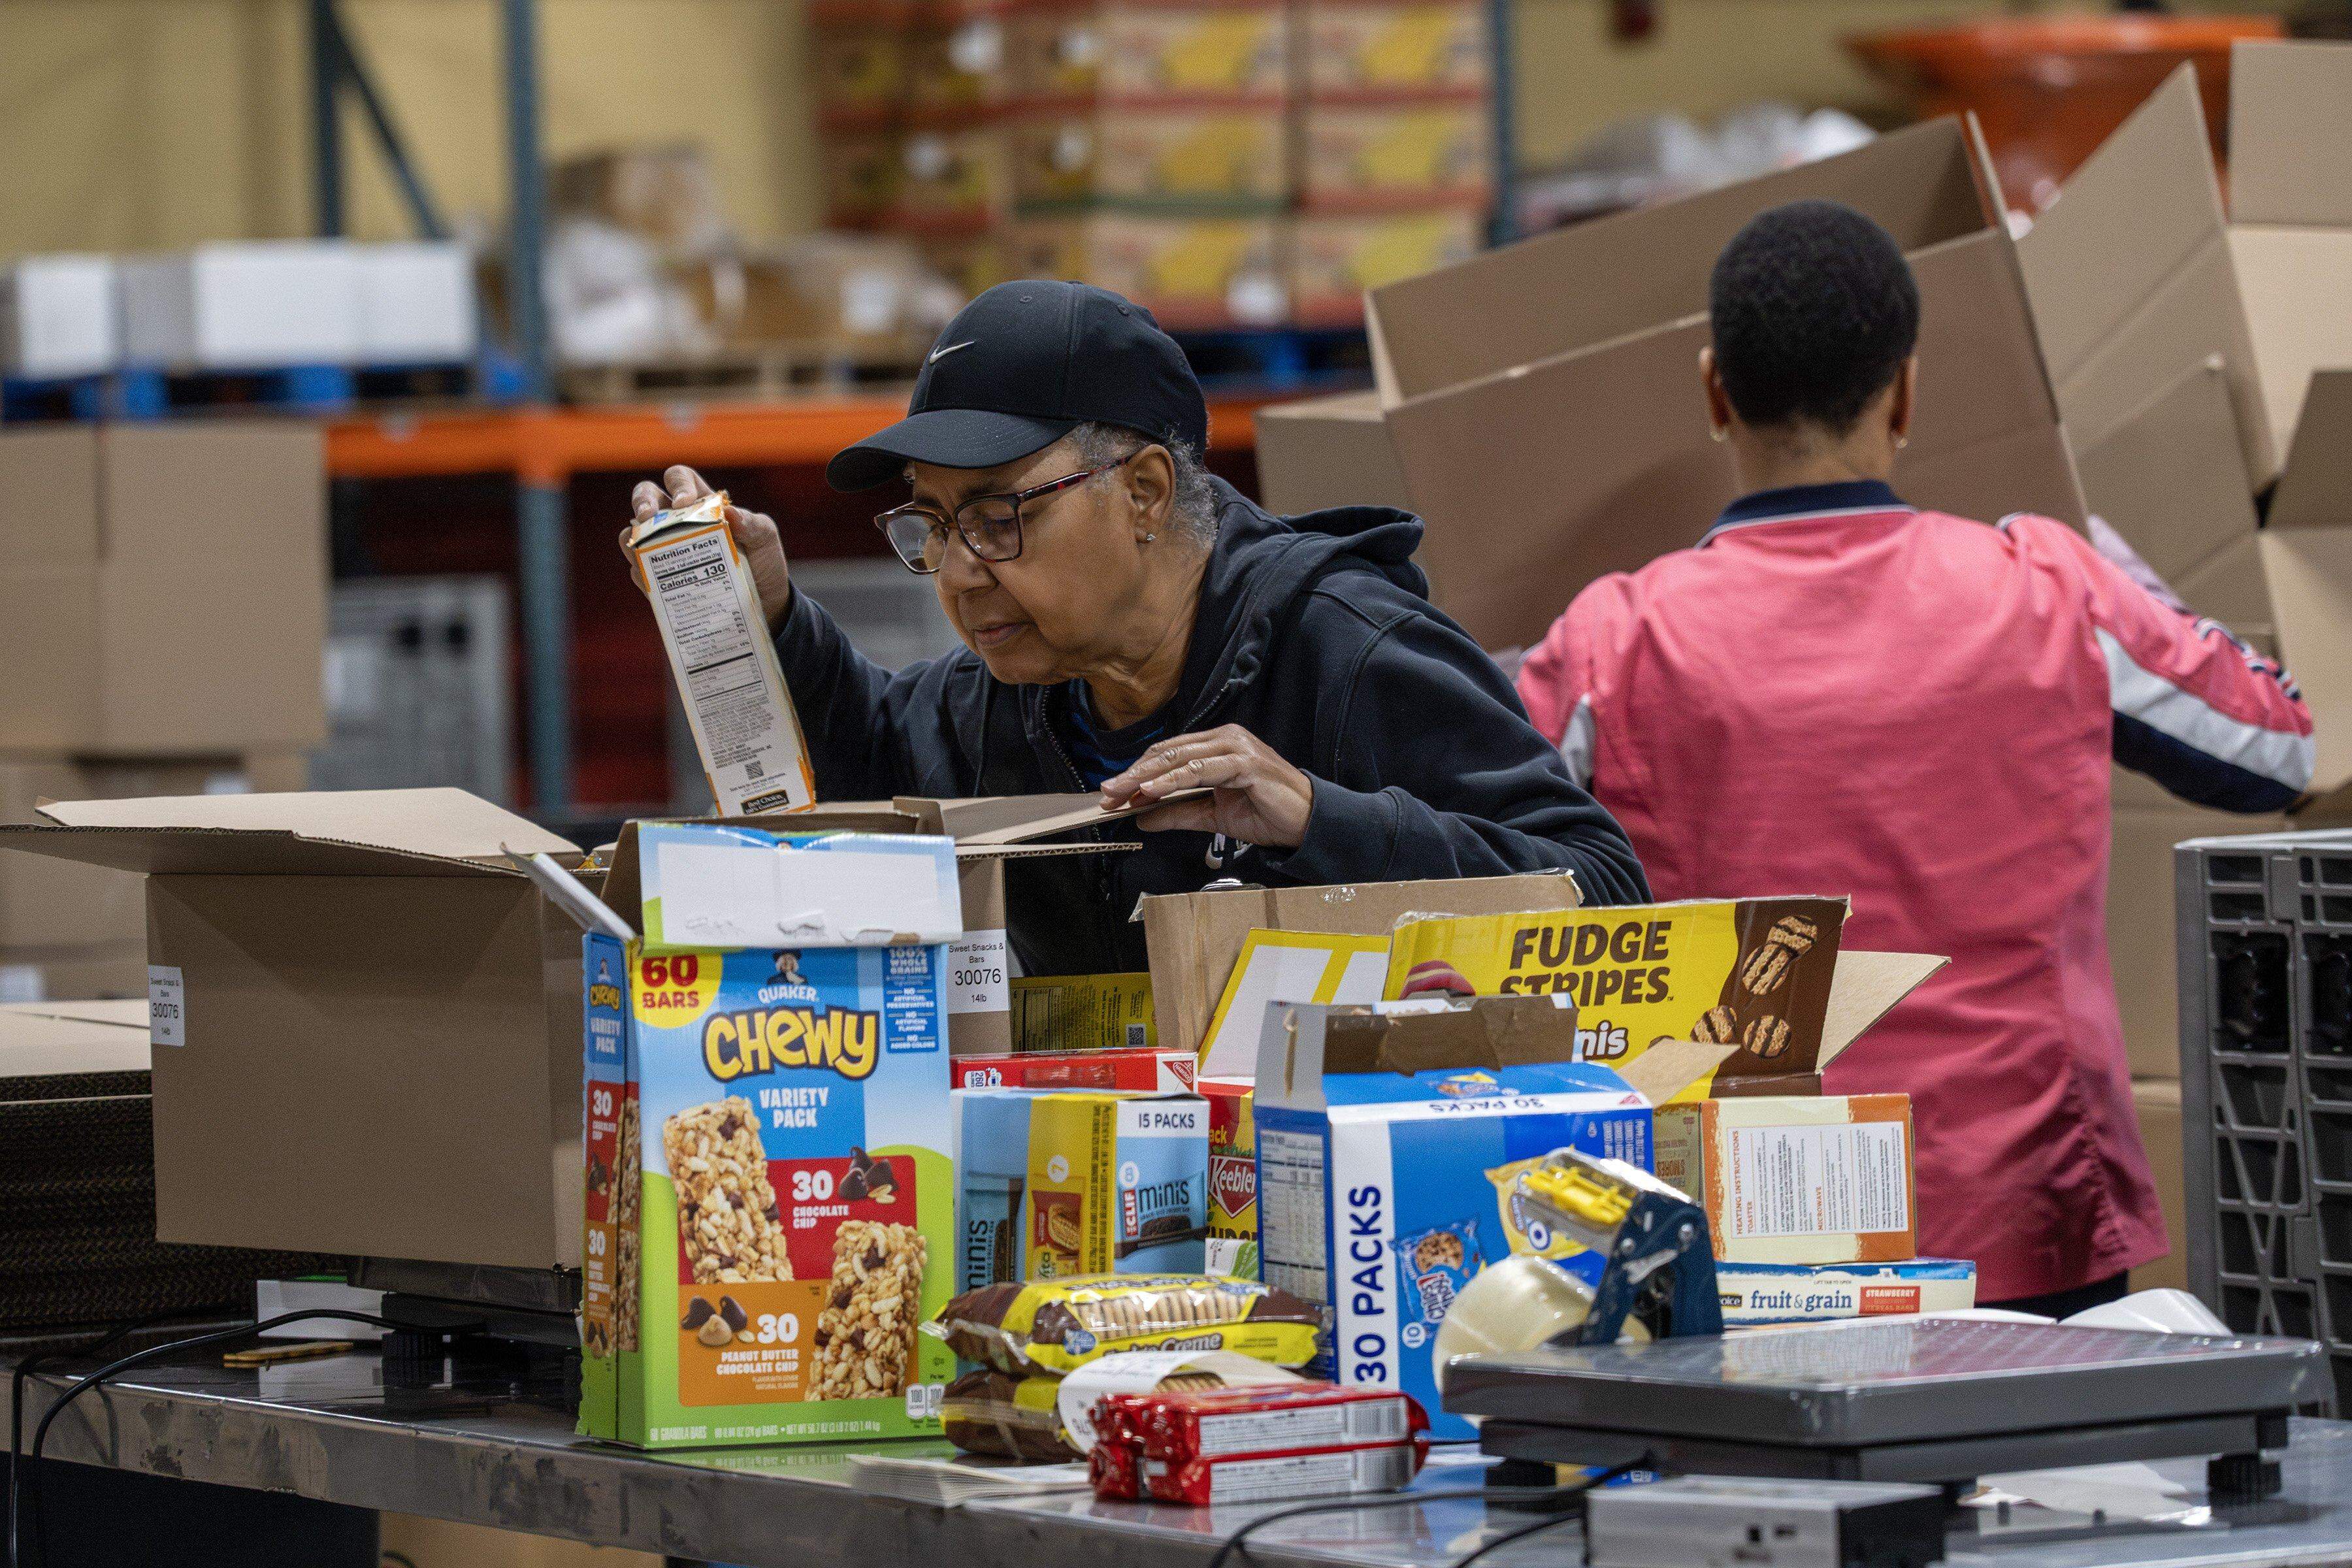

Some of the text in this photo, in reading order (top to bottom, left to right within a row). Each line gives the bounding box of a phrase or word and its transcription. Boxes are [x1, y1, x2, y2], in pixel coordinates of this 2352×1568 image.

[650, 538, 718, 563] Nutrition Facts
[660, 563, 726, 591] Calories 130
[972, 943, 996, 951] Snacks
[1509, 921, 1672, 970] FUDGE
[969, 955, 985, 964] Bars
[642, 955, 698, 988] 60
[955, 968, 1001, 986] 30076
[642, 990, 700, 1009] BARS
[758, 985, 817, 1004] QUAKER
[971, 994, 987, 1003] 14lb
[153, 1002, 179, 1019] 30076
[596, 1036, 617, 1055] PACK
[1580, 1020, 1628, 1060] nis
[975, 1071, 984, 1087] 260
[593, 1089, 612, 1118] 30
[759, 1086, 829, 1109] VARIETY
[1429, 1098, 1546, 1113] 30 PACKS
[773, 1106, 817, 1129] PACK
[1139, 1113, 1196, 1129] 15 PACKS
[1209, 1125, 1227, 1144] ack
[1732, 1130, 1740, 1194] INSTRUCTIONS
[792, 1169, 834, 1201] 30
[1139, 1181, 1190, 1213] minis
[792, 1205, 849, 1217] CHOCOLATE
[1124, 1190, 1137, 1226] CLIF
[792, 1217, 817, 1230] CHIP
[589, 1229, 606, 1256] 30
[968, 1219, 988, 1291] minis
[1348, 1186, 1387, 1383] 30 PACKS
[1865, 1289, 1916, 1298] STRAWBERRY
[1720, 1296, 1741, 1307] oice
[1750, 1290, 1792, 1309] fruit
[1805, 1290, 1853, 1312] grain
[757, 1313, 799, 1345] 30
[1407, 1326, 1420, 1344] 10
[721, 1348, 799, 1362] PEANUT BUTTER
[716, 1360, 799, 1375] CHOCOLATE CHIP
[911, 1389, 923, 1403] 100
